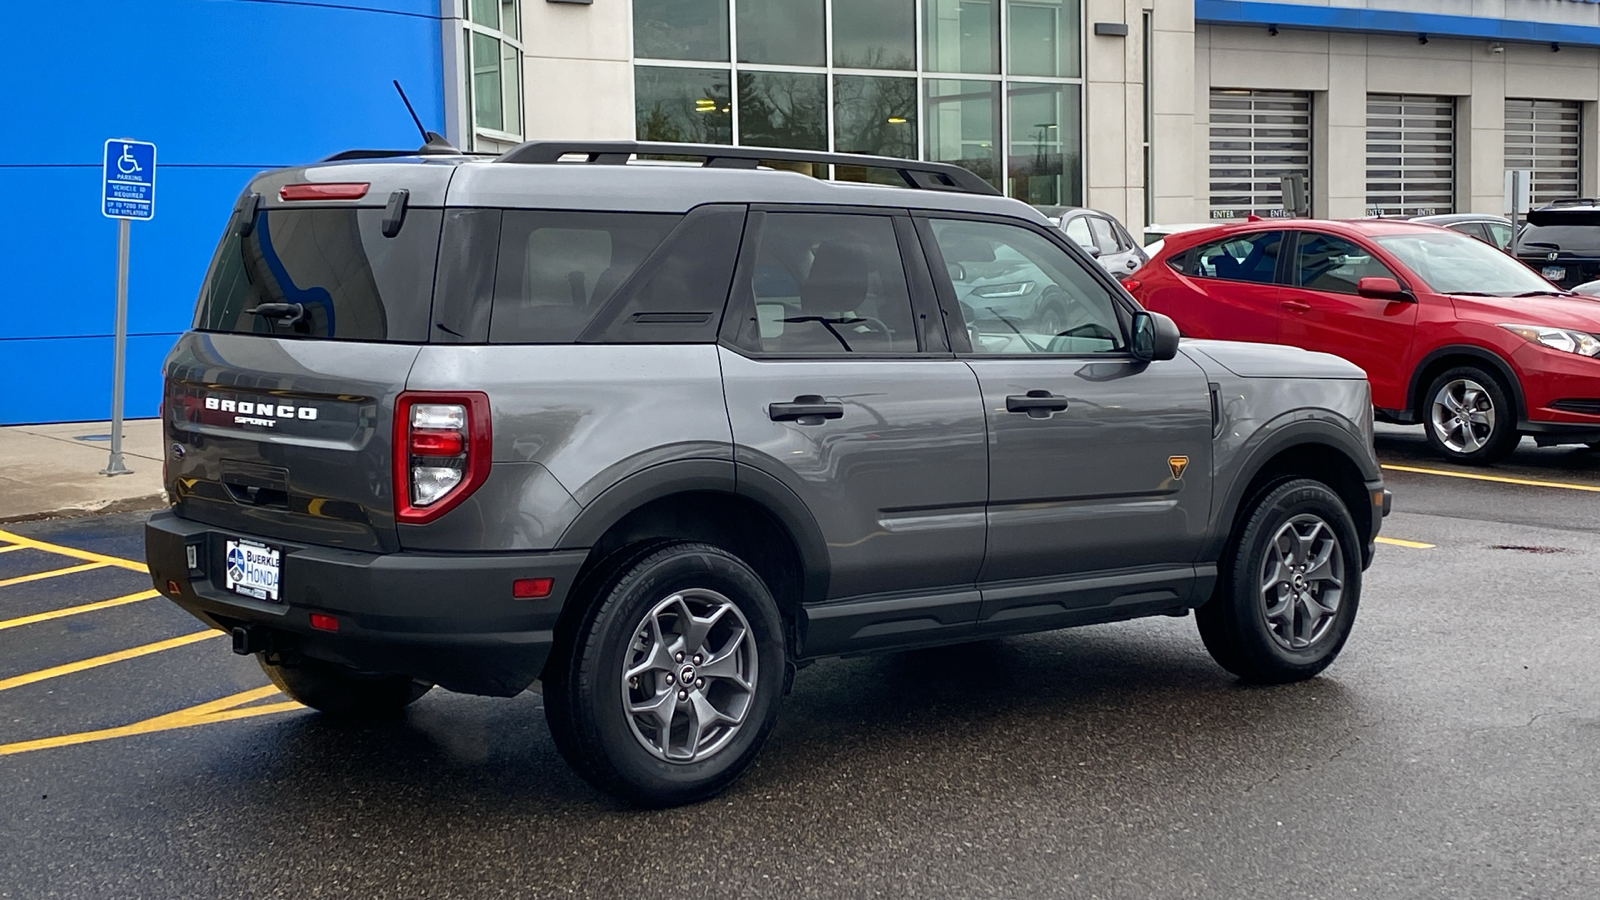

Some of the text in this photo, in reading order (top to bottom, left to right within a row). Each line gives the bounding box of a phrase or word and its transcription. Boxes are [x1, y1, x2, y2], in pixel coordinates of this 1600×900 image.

[1213, 210, 1235, 218] ENTER
[1417, 208, 1436, 216] ENTER
[206, 398, 318, 420] BRONCO
[234, 416, 276, 427] SPORT
[246, 550, 280, 568] BUERKLE
[246, 563, 278, 587] HONDA
